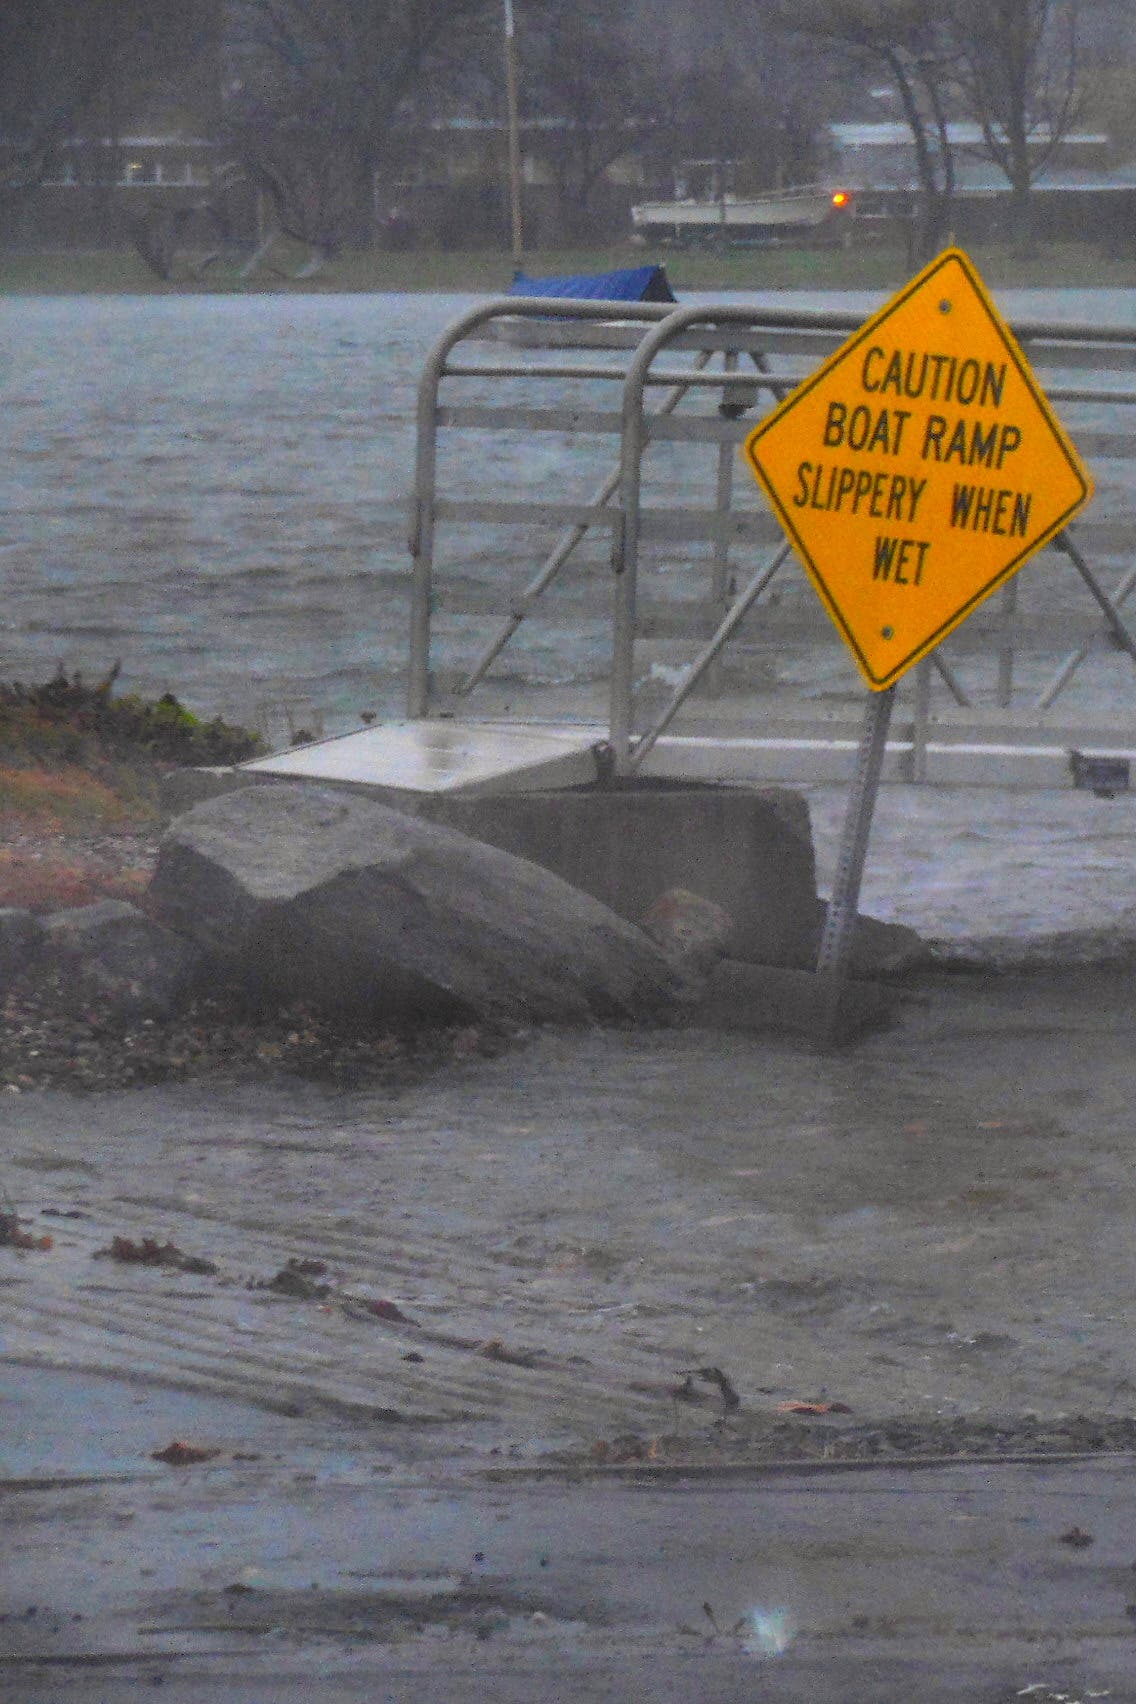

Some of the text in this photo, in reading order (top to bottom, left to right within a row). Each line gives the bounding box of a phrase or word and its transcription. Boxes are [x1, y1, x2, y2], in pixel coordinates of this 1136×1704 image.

[861, 346, 1007, 408] CAUTION
[822, 402, 1022, 469] BOAT RAMP
[792, 461, 1032, 538] SLIPPERY WHEN
[872, 535, 931, 586] WET
